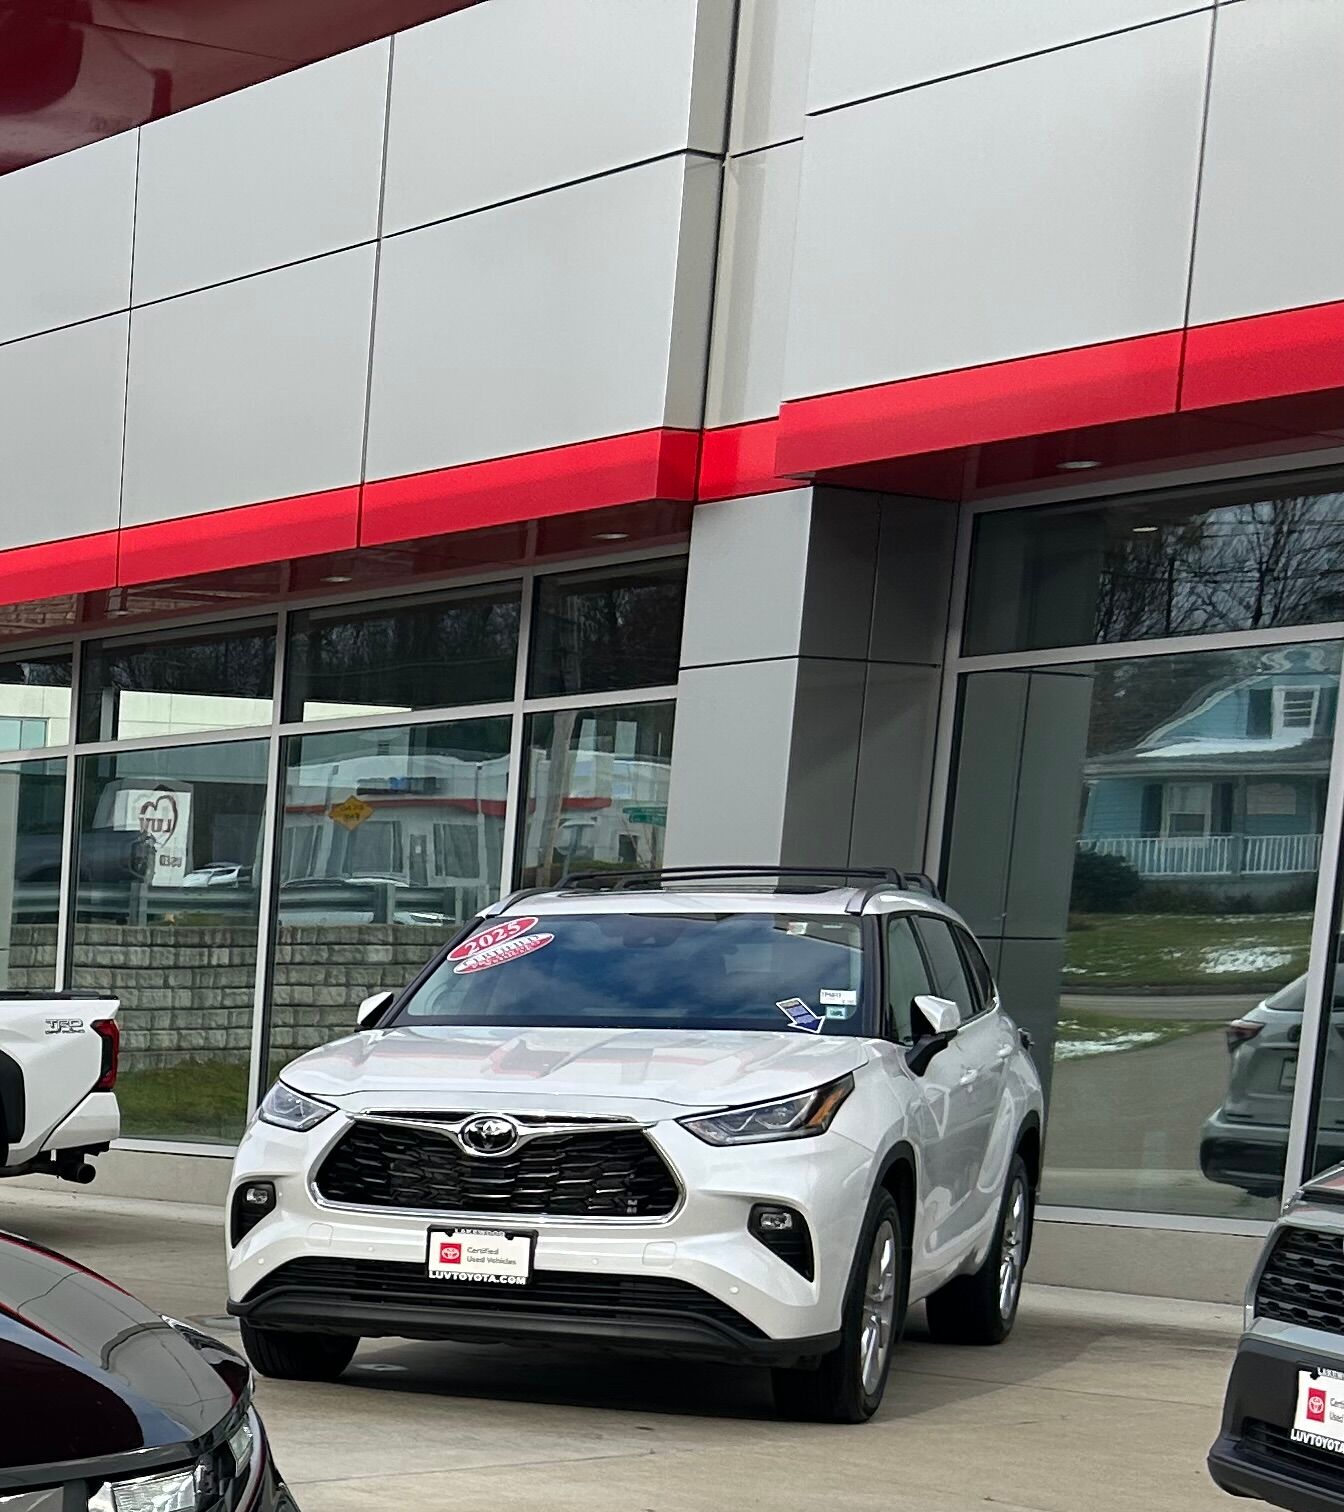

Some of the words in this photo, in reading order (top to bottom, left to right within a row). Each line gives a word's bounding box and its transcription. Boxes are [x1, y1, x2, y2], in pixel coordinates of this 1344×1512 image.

[463, 921, 521, 956] 2025
[467, 1247, 499, 1255] Certified
[487, 1257, 516, 1265] Vehicles
[429, 1270, 527, 1285] LUVTOYOTA.COM
